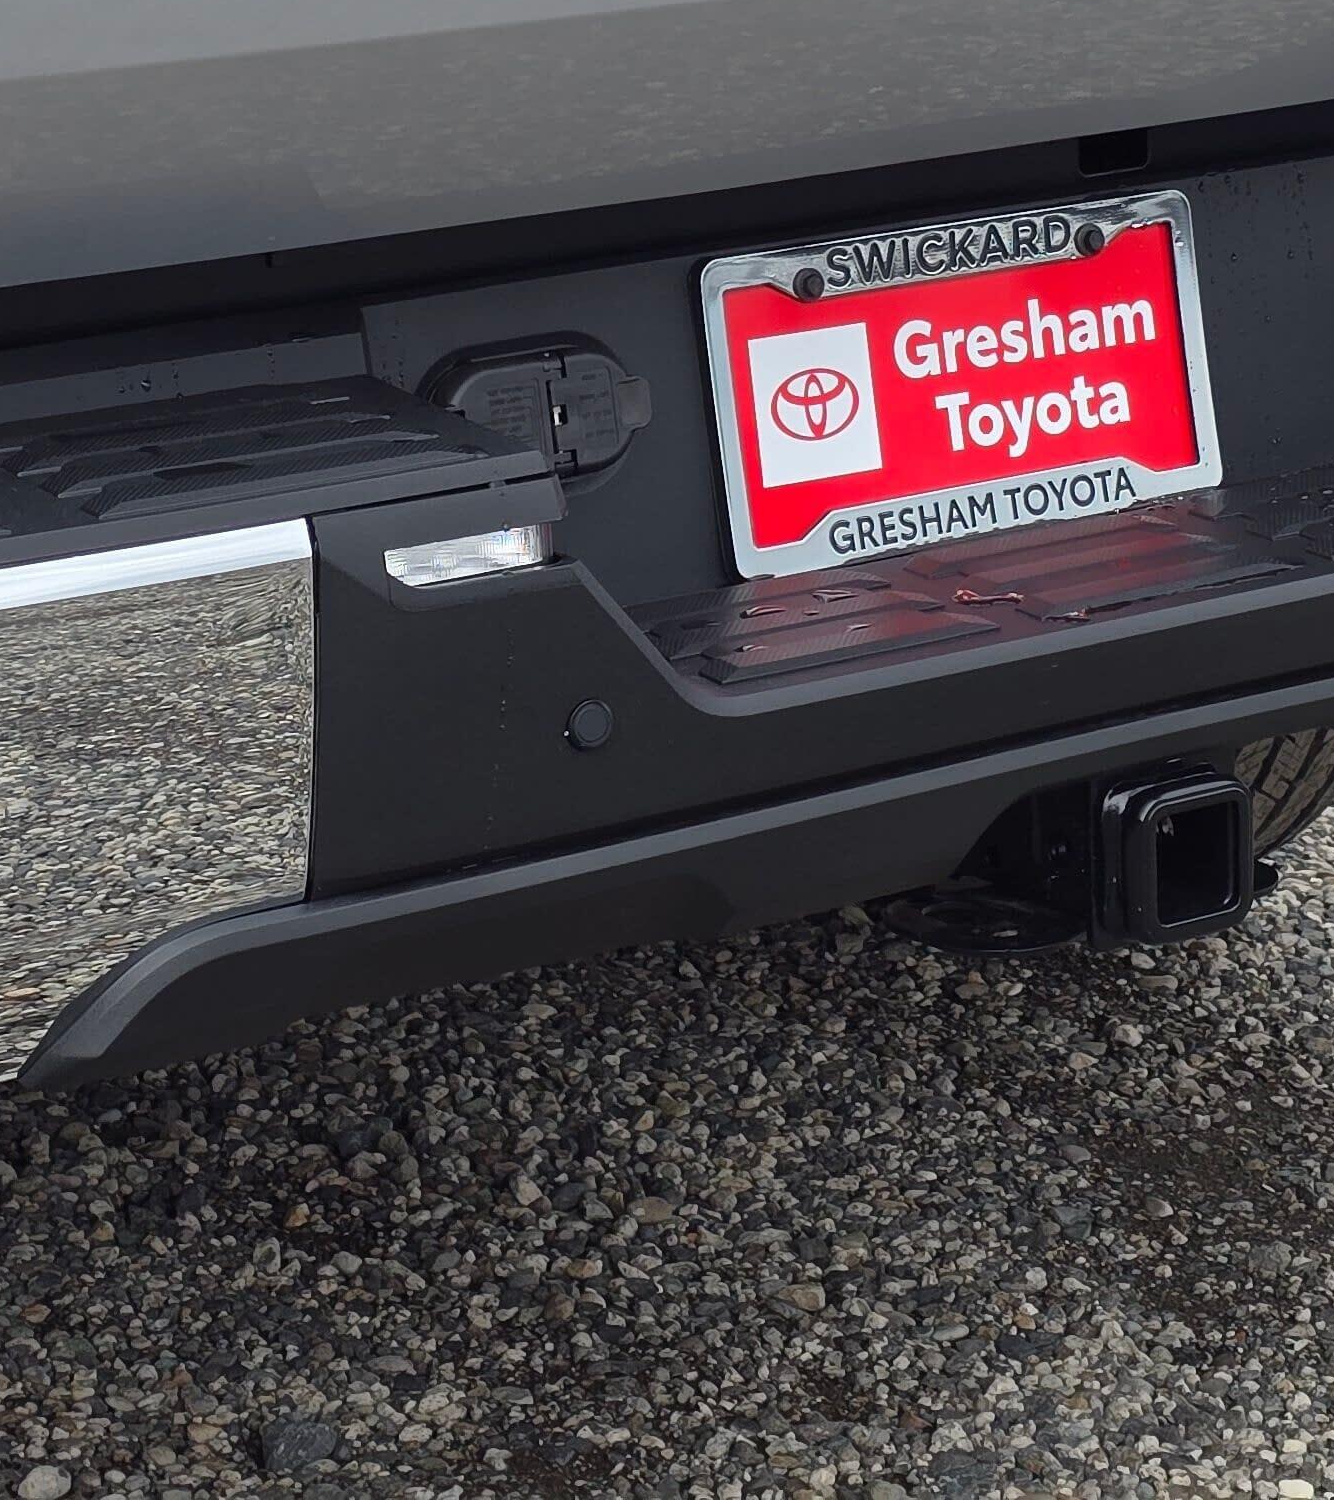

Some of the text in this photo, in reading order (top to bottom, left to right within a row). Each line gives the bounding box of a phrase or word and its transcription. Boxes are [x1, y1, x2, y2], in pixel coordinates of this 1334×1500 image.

[825, 213, 1071, 289] SWICKARD
[893, 298, 1156, 380] Gresham
[935, 376, 1131, 458] Toyota
[828, 467, 1136, 555] GRESHAM TOYOTA
